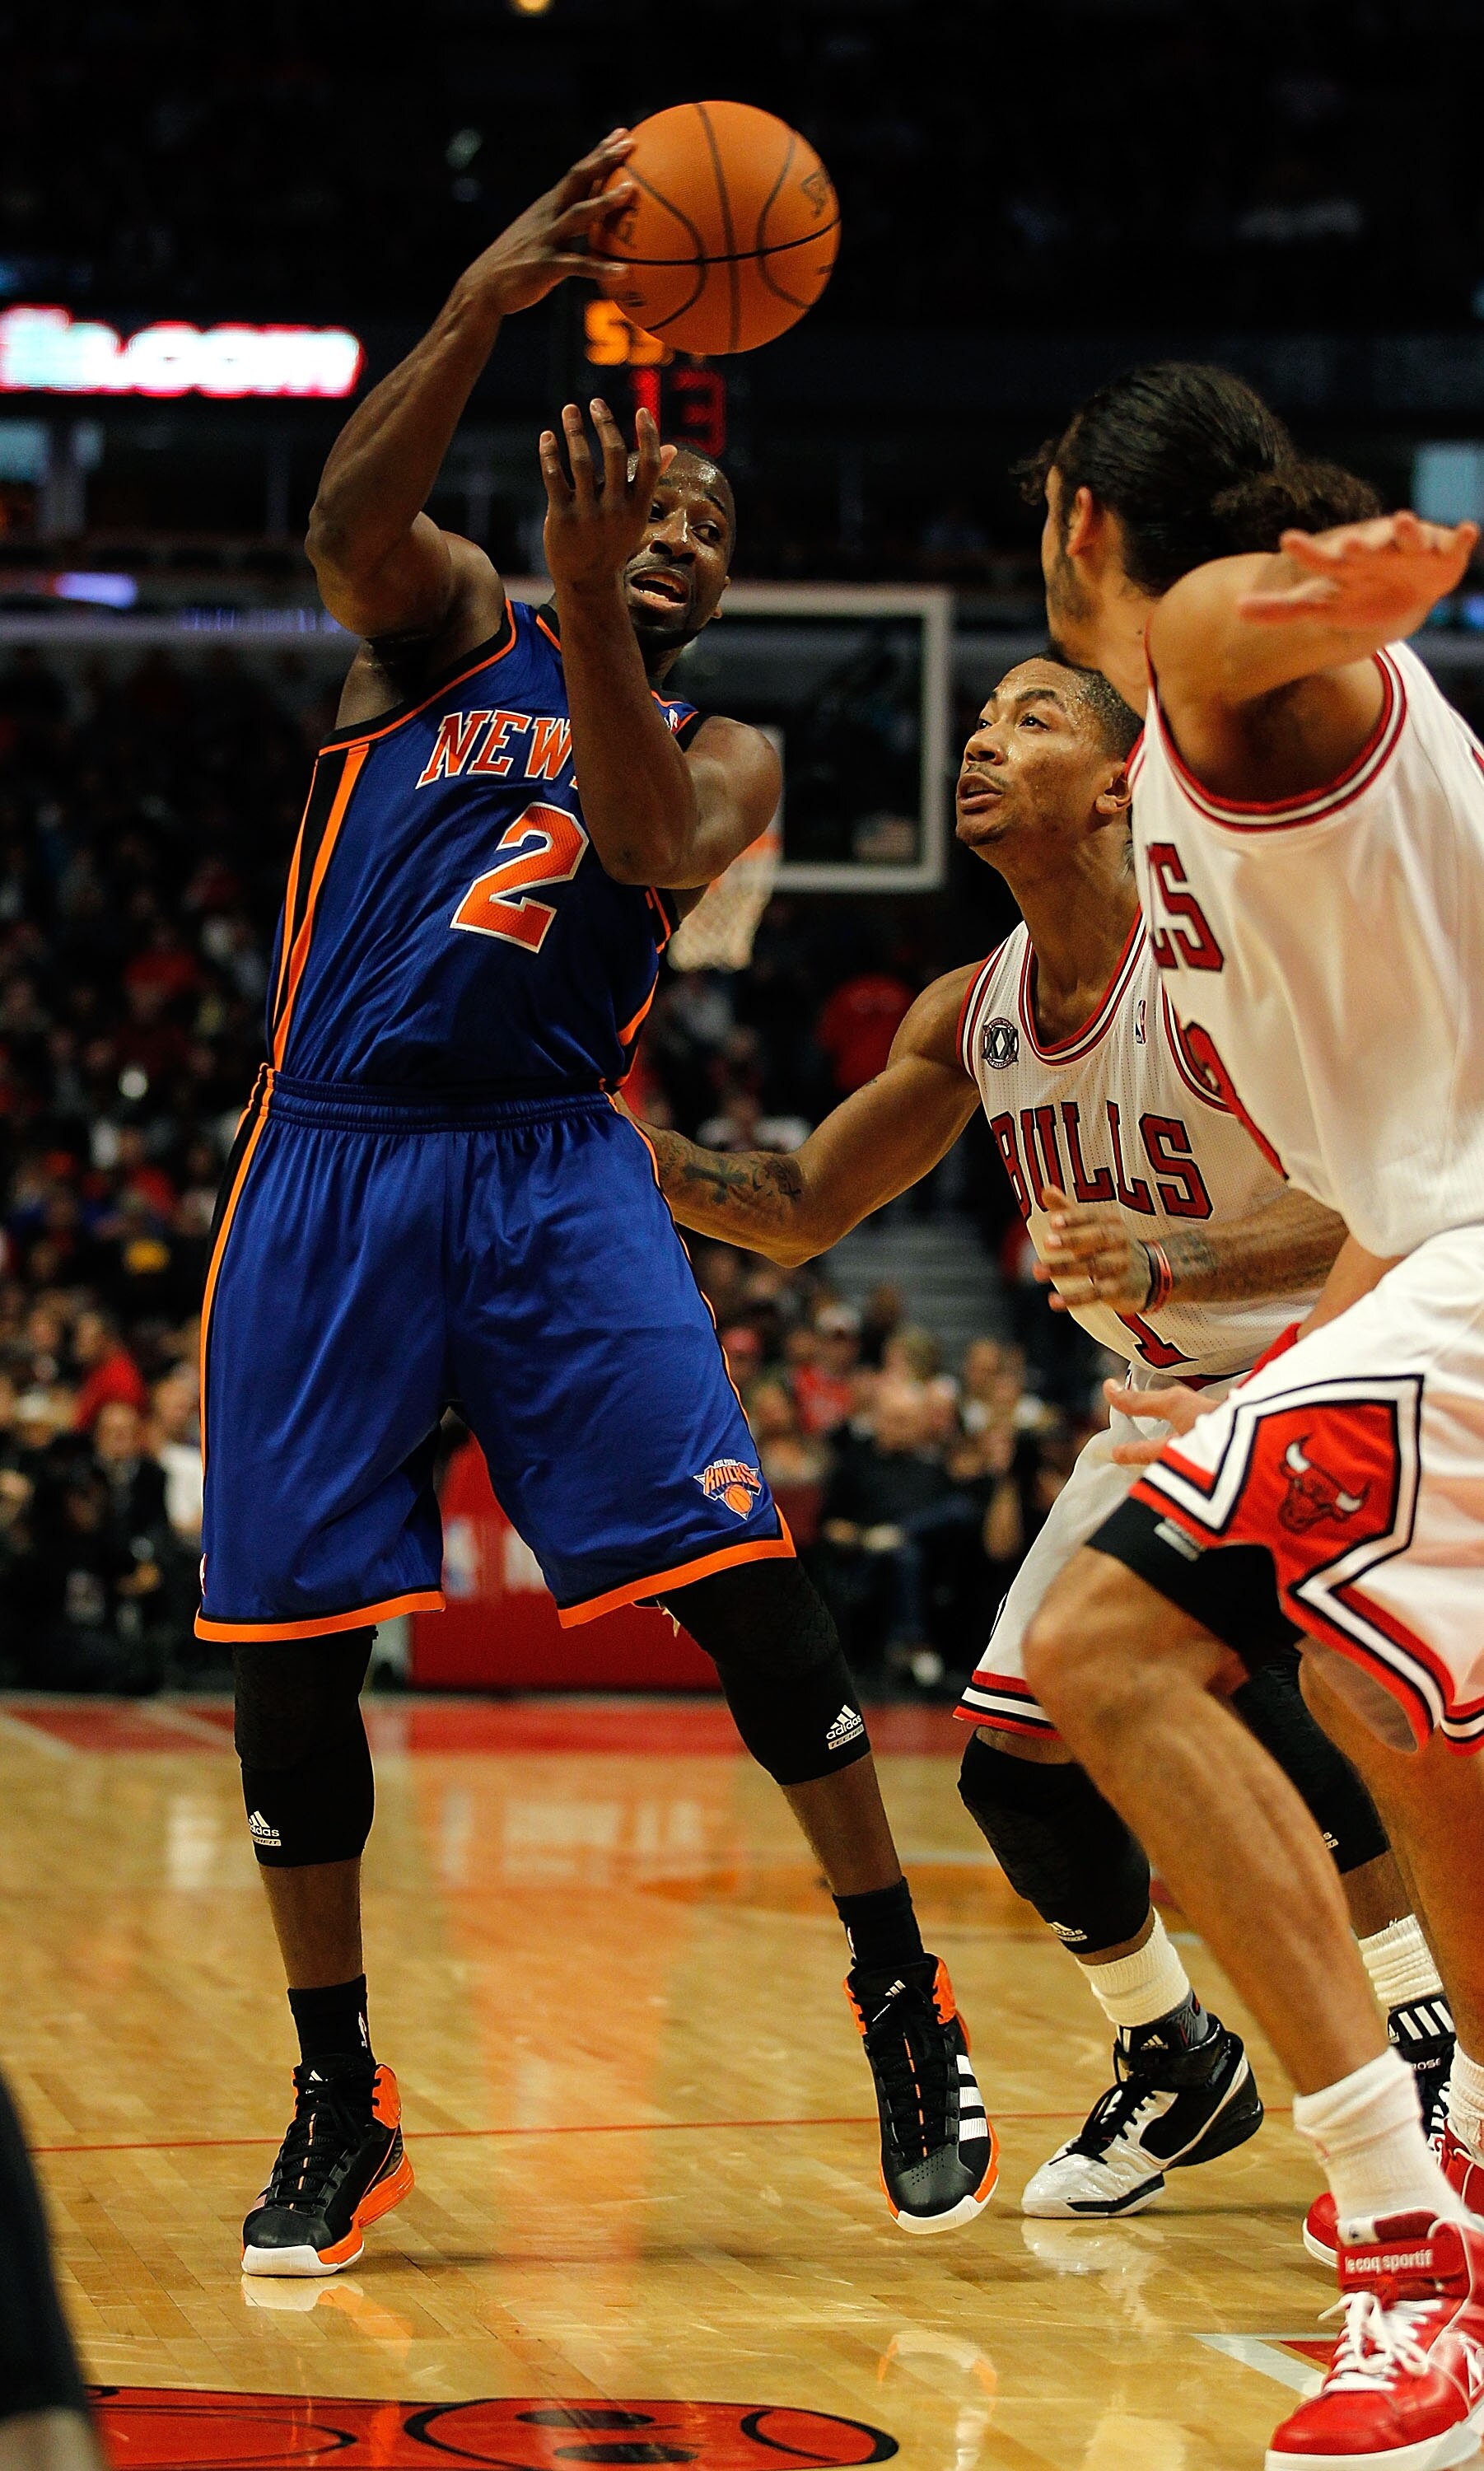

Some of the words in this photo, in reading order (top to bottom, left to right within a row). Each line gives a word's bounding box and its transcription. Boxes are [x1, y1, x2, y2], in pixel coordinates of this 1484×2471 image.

[415, 710, 574, 789] NEW
[450, 801, 589, 954] 2
[989, 1100, 1214, 1221] BULLS
[704, 1463, 762, 1497] KNICKS
[826, 1714, 862, 1740] adidas
[1356, 2255, 1381, 2275] coq
[1383, 2249, 1432, 2273] sportif
